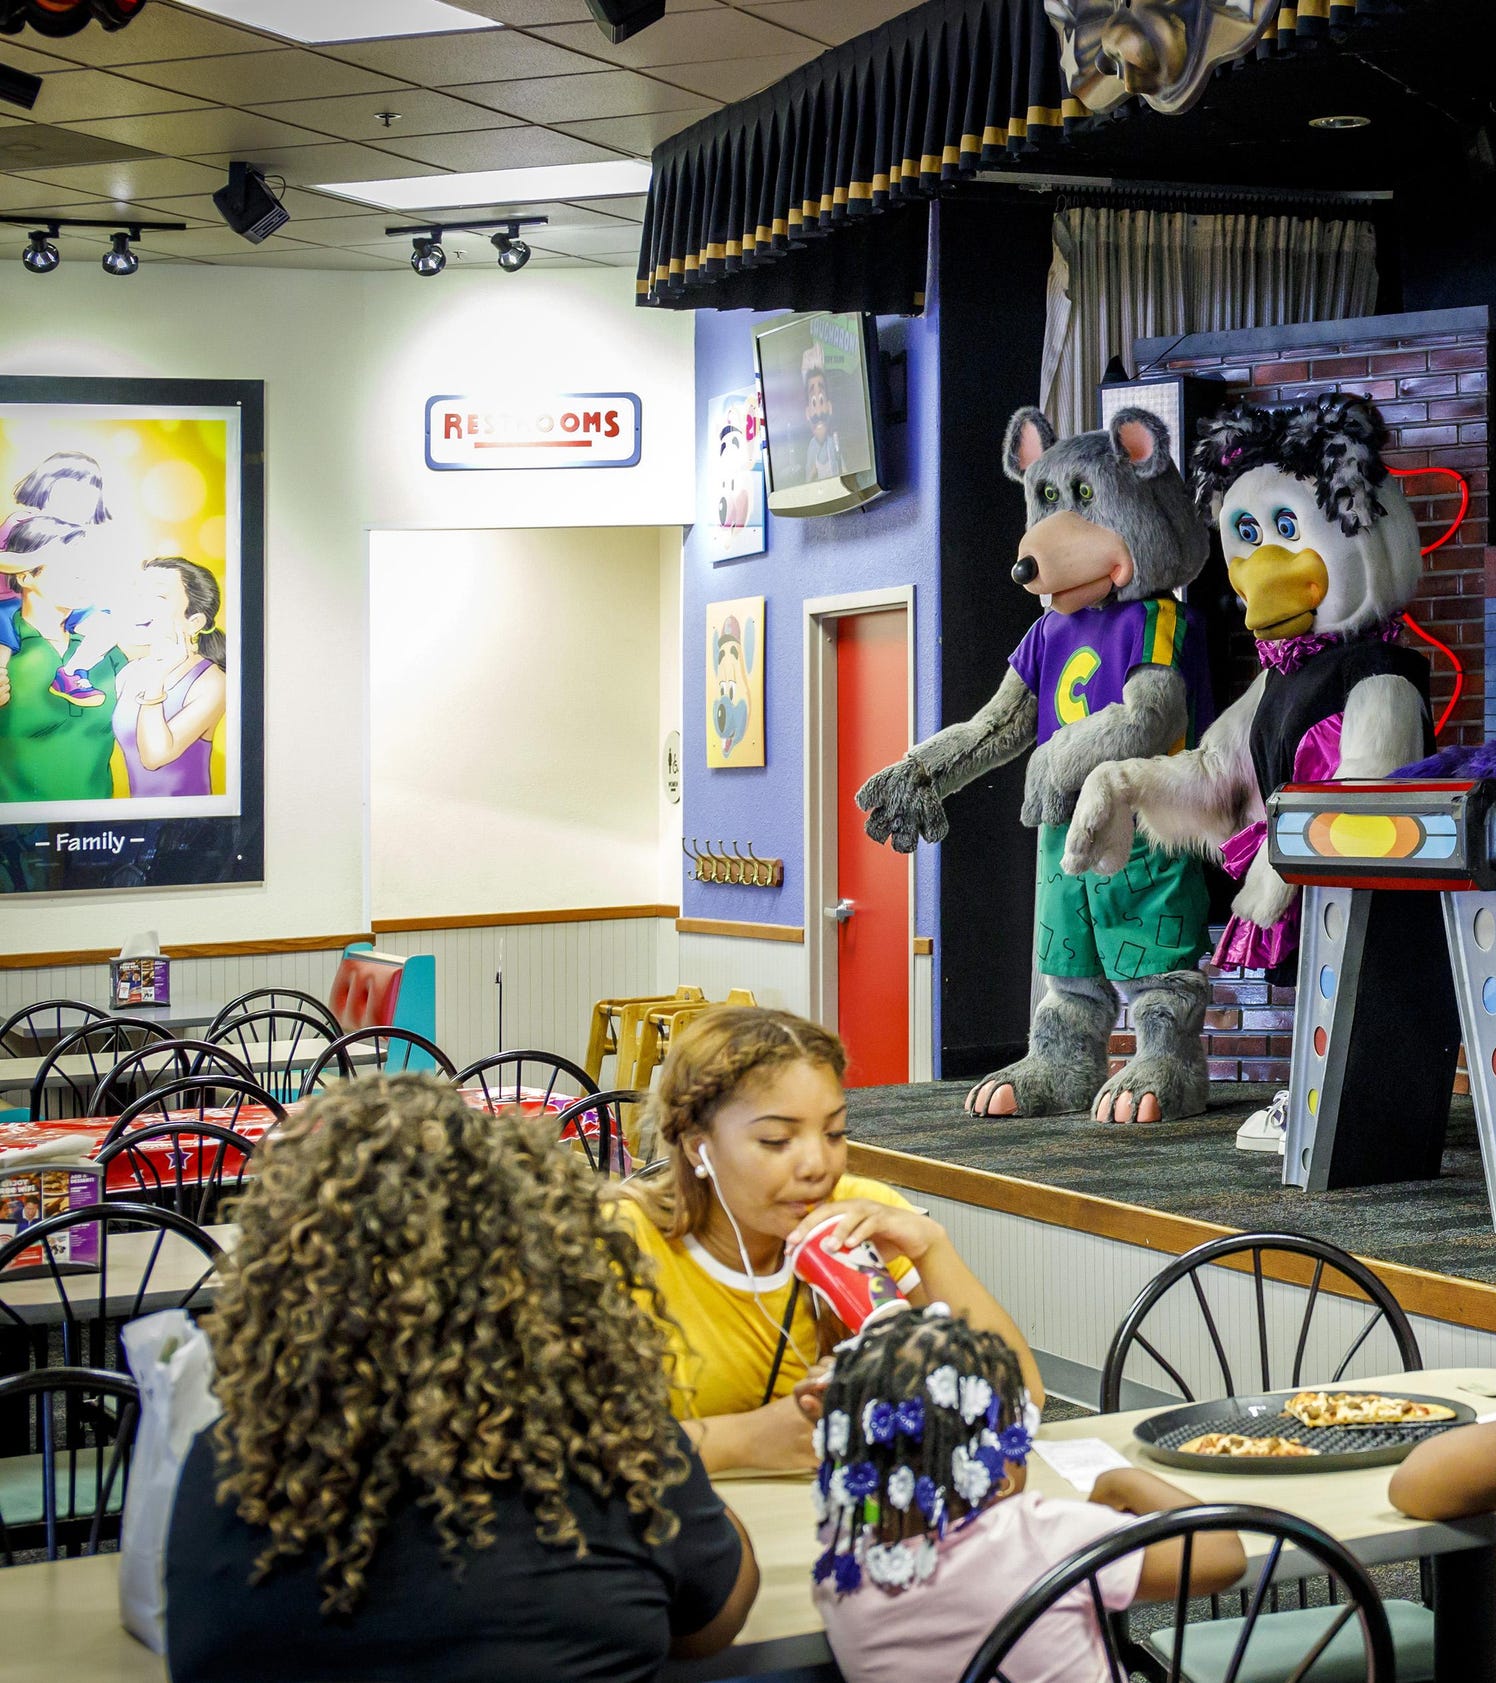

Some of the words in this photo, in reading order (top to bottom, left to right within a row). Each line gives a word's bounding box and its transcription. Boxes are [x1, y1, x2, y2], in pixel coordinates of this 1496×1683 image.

[444, 410, 620, 439] RESOOMS
[1055, 645, 1101, 727] C
[56, 831, 125, 854] Family
